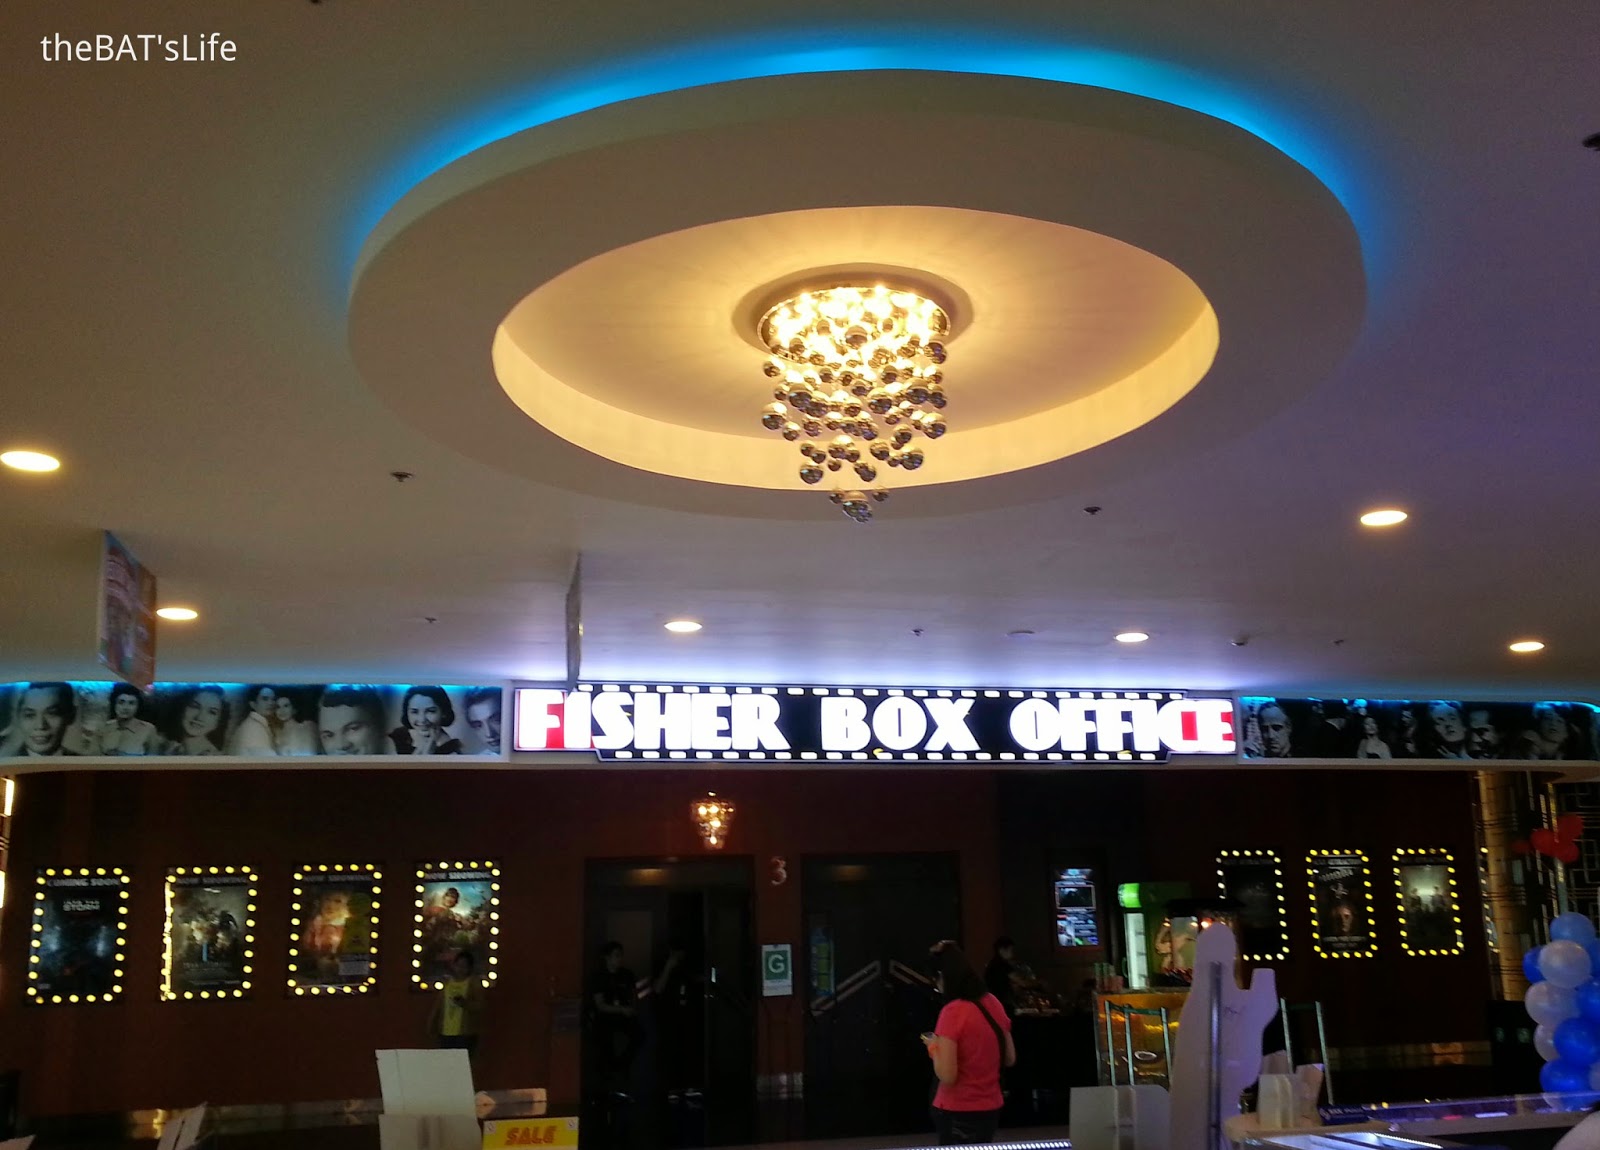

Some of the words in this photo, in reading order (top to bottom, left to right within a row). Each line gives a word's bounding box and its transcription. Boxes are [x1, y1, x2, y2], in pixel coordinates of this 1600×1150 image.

[517, 688, 792, 751] FISHER
[821, 695, 981, 752] BOX
[1008, 698, 1237, 754] OFFICE
[769, 855, 788, 886] 3
[47, 877, 89, 887] COMING
[90, 877, 120, 886] SOON
[62, 903, 101, 912] STORM
[768, 954, 785, 974] G
[505, 1125, 558, 1146] SALE
